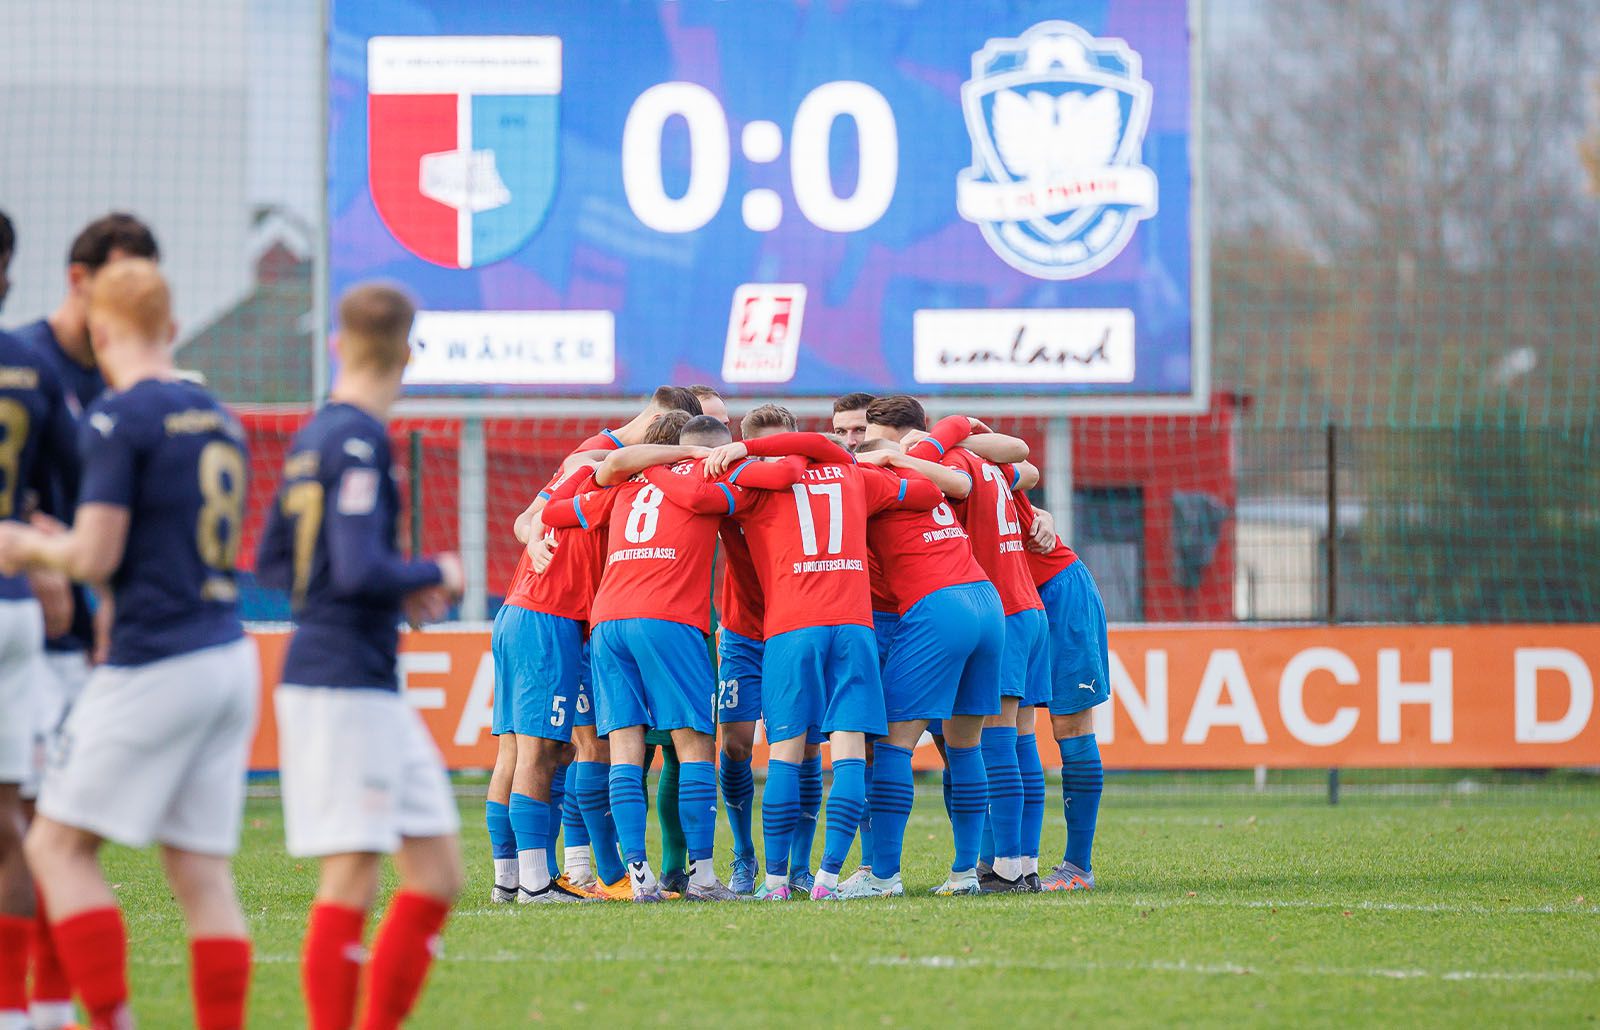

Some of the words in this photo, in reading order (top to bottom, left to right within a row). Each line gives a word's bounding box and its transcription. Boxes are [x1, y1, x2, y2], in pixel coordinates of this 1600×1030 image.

[621, 80, 899, 233] 0:0
[938, 323, 1112, 366] umland
[197, 440, 245, 571] 8
[624, 482, 665, 544] 8
[791, 482, 843, 556] 17
[793, 562, 802, 574] SV
[550, 695, 567, 727] 5
[717, 678, 739, 710] 23
[1094, 647, 1453, 748] NACH
[1514, 646, 1595, 744] D
